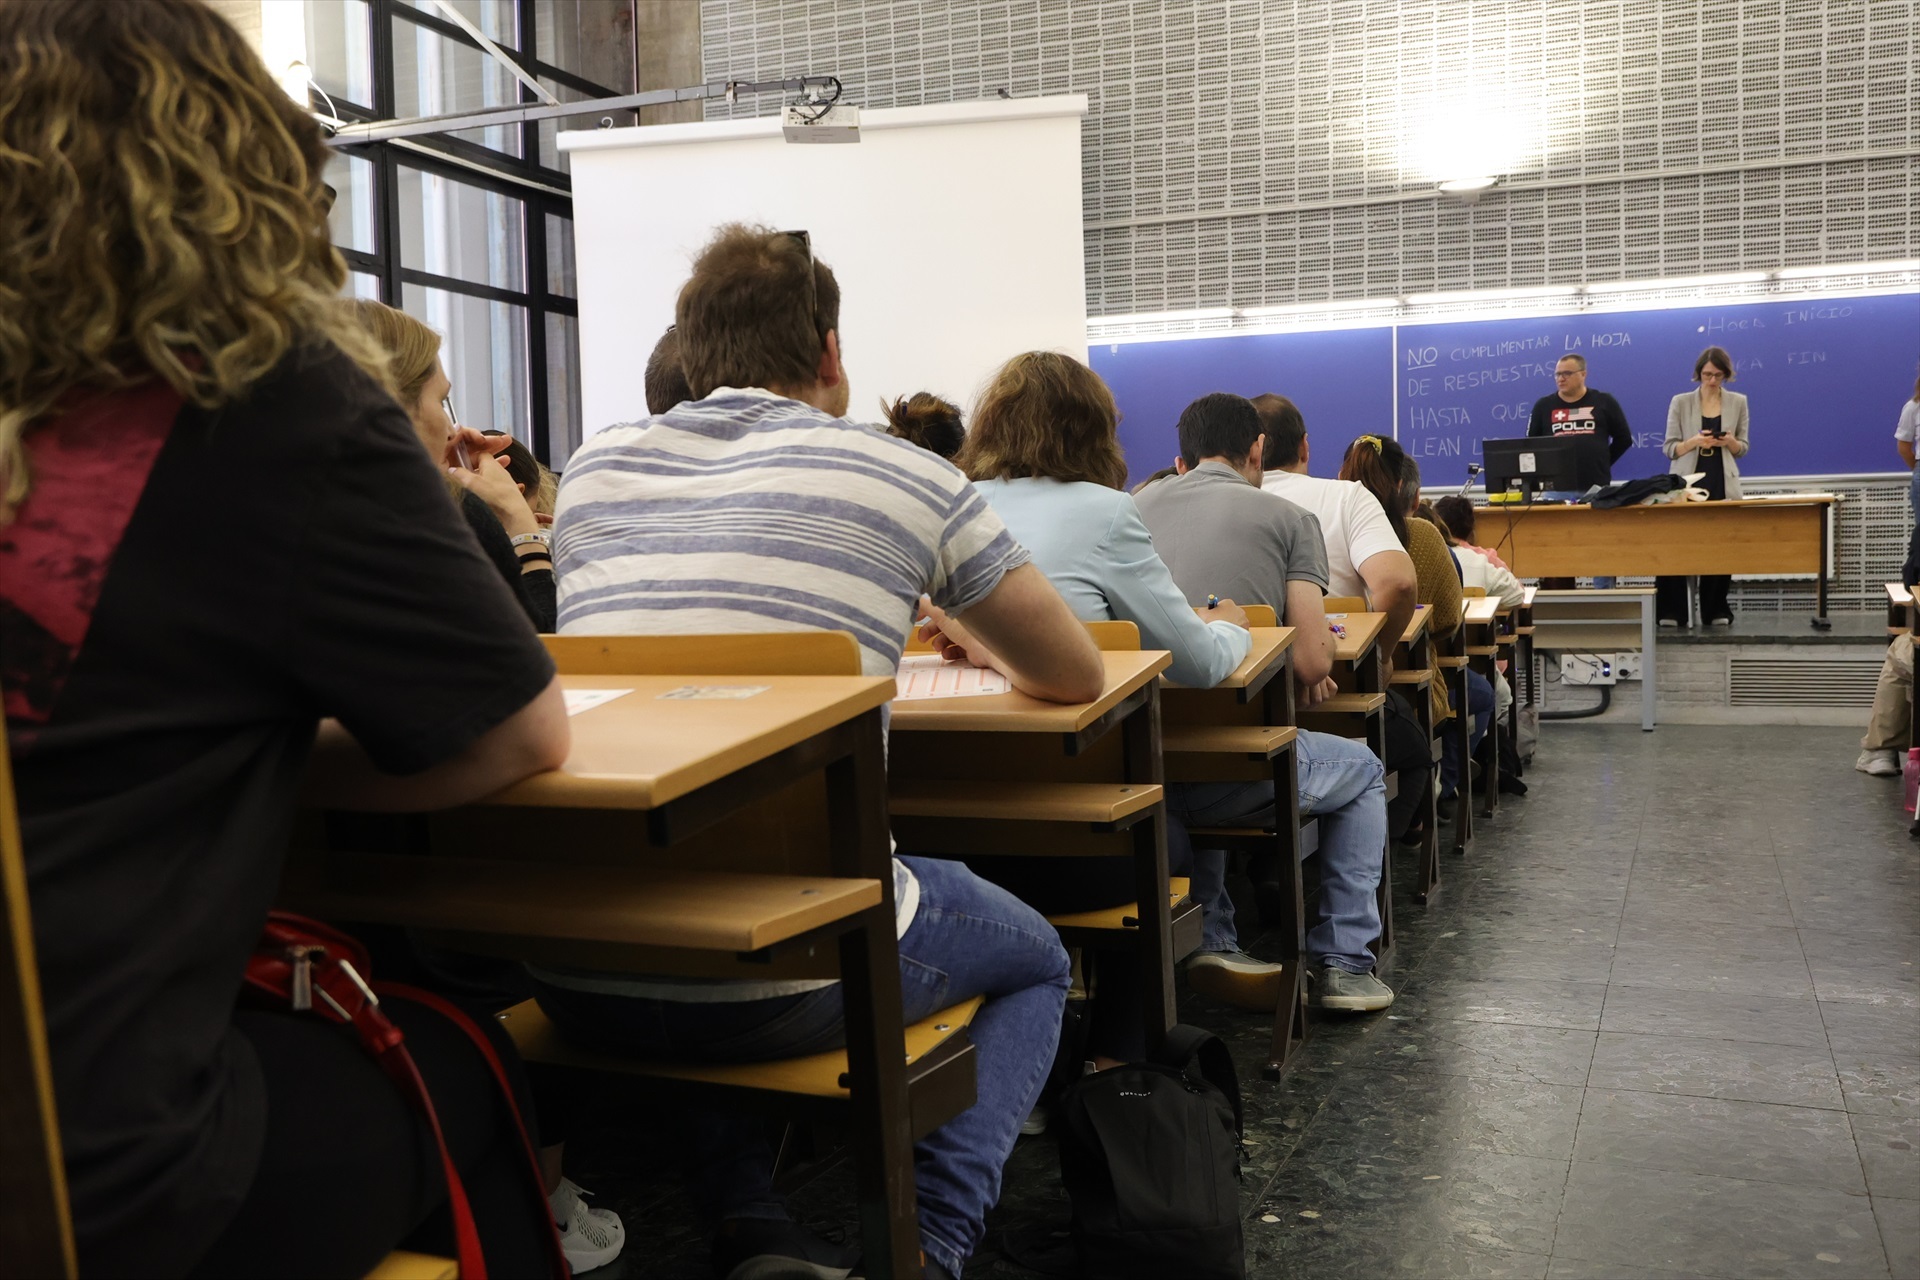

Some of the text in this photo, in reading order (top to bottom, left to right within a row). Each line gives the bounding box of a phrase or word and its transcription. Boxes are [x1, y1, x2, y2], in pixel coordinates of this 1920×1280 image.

[1407, 332, 1631, 367] NO CUMPLIMENTAR LA HOJA
[1787, 352, 1826, 365] FIN
[1407, 361, 1557, 397] DE RESPUESTAS
[1410, 402, 1530, 430] HASTA QUE
[1552, 421, 1595, 433] POLO
[1411, 435, 1460, 457] LEAN
